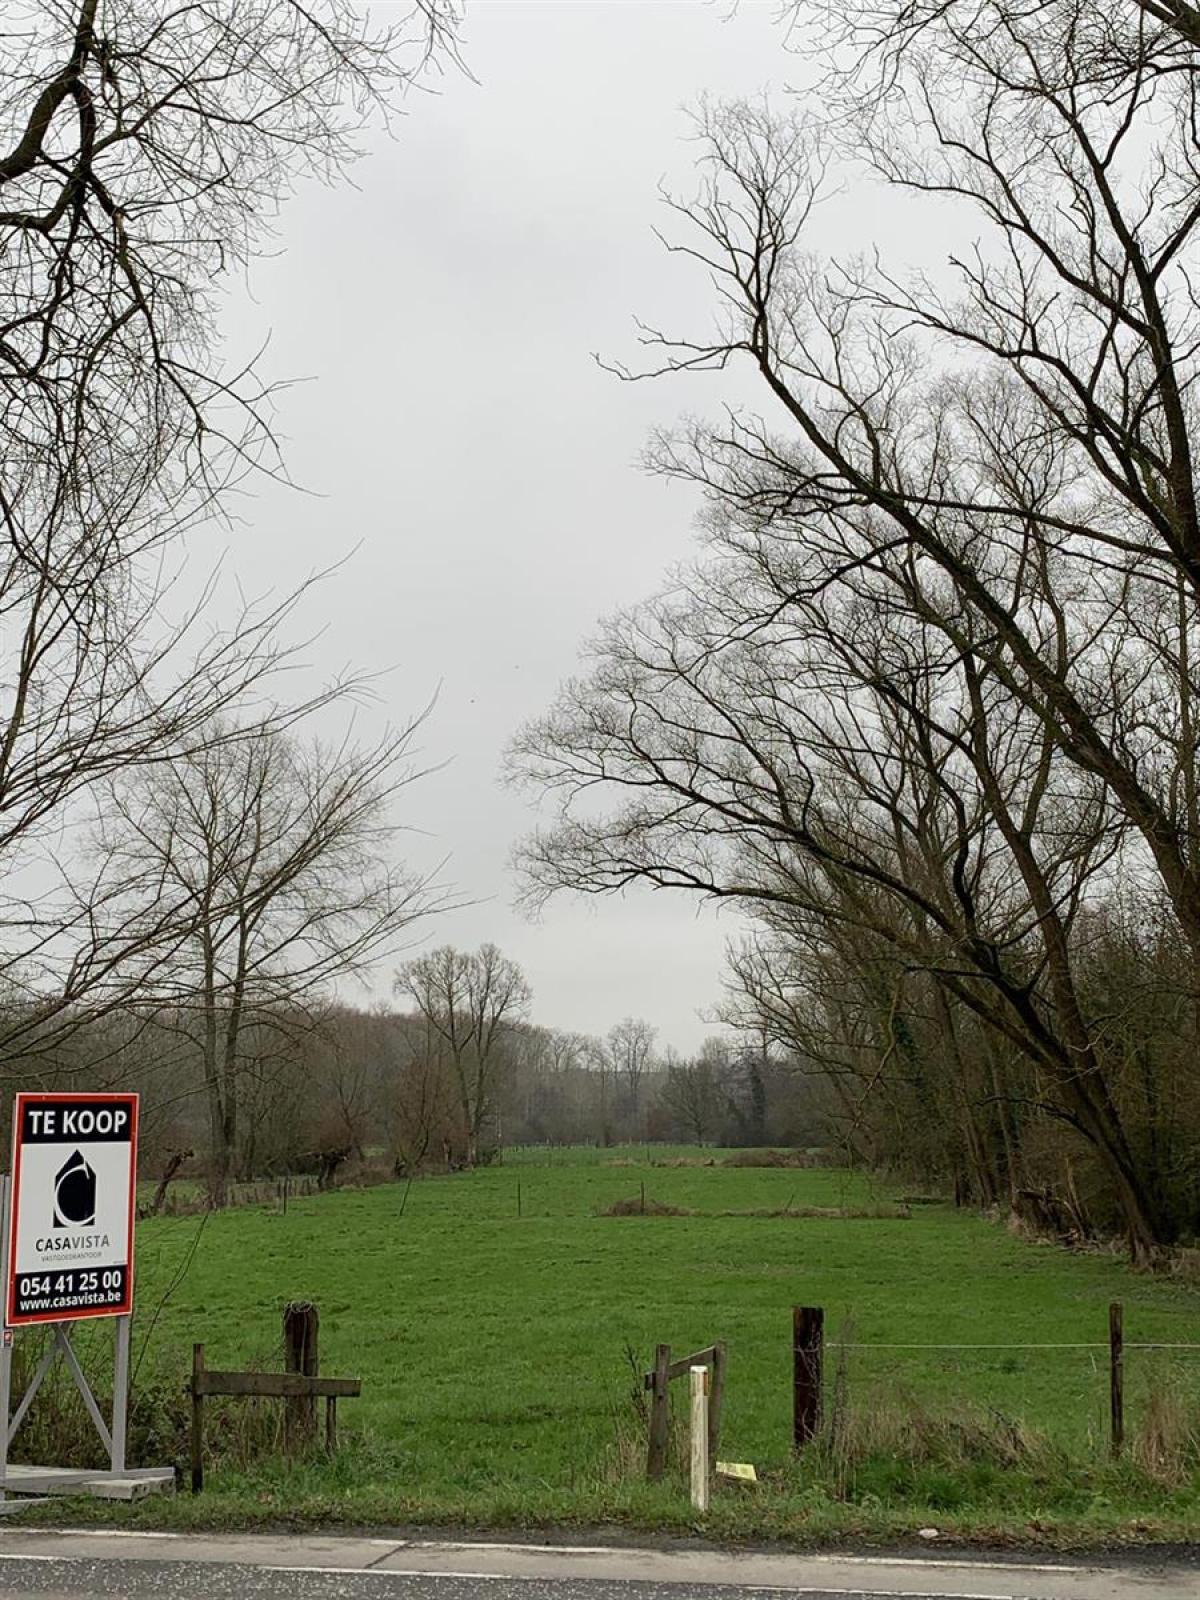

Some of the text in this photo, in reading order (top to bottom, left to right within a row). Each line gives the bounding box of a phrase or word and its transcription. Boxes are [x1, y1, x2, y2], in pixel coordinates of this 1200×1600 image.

[28, 1110, 127, 1134] TE KOOP
[35, 1235, 110, 1252] CASAVISTA
[20, 1270, 121, 1296] 054 41 25 00
[19, 1290, 121, 1311] www.casavista.be
